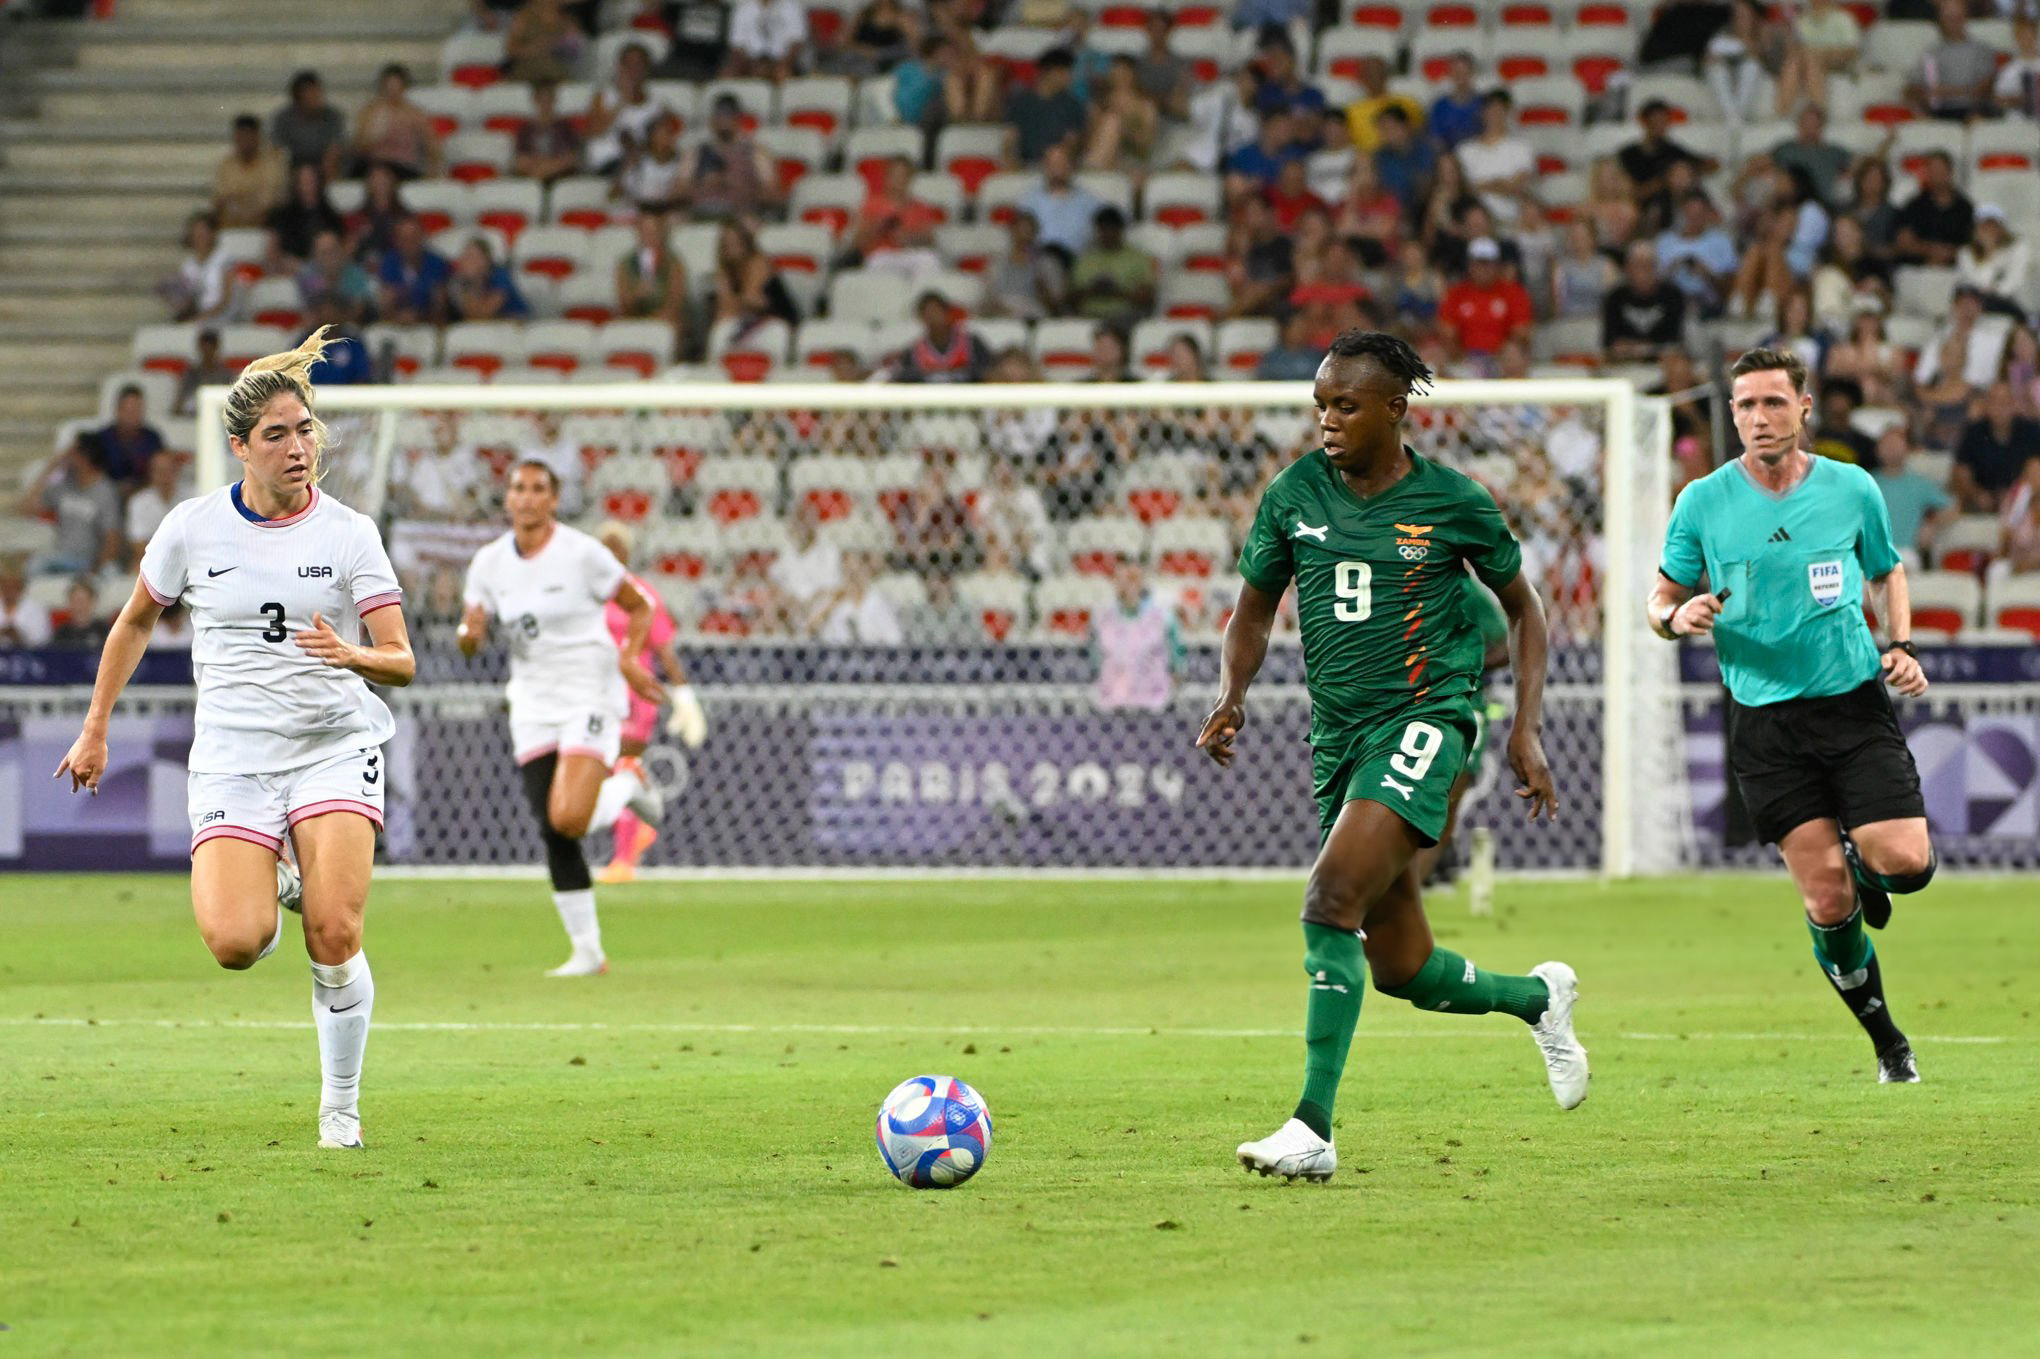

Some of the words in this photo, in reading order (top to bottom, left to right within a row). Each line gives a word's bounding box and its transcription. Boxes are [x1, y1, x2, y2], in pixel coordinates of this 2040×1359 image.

[1396, 537, 1431, 546] ZAMBIA
[297, 566, 333, 578] USA
[1812, 565, 1839, 577] FIFA
[1334, 561, 1371, 621] 9
[260, 602, 287, 643] 3
[1390, 721, 1443, 780] 9
[1030, 761, 1185, 806] 2024
[198, 810, 225, 826] USA
